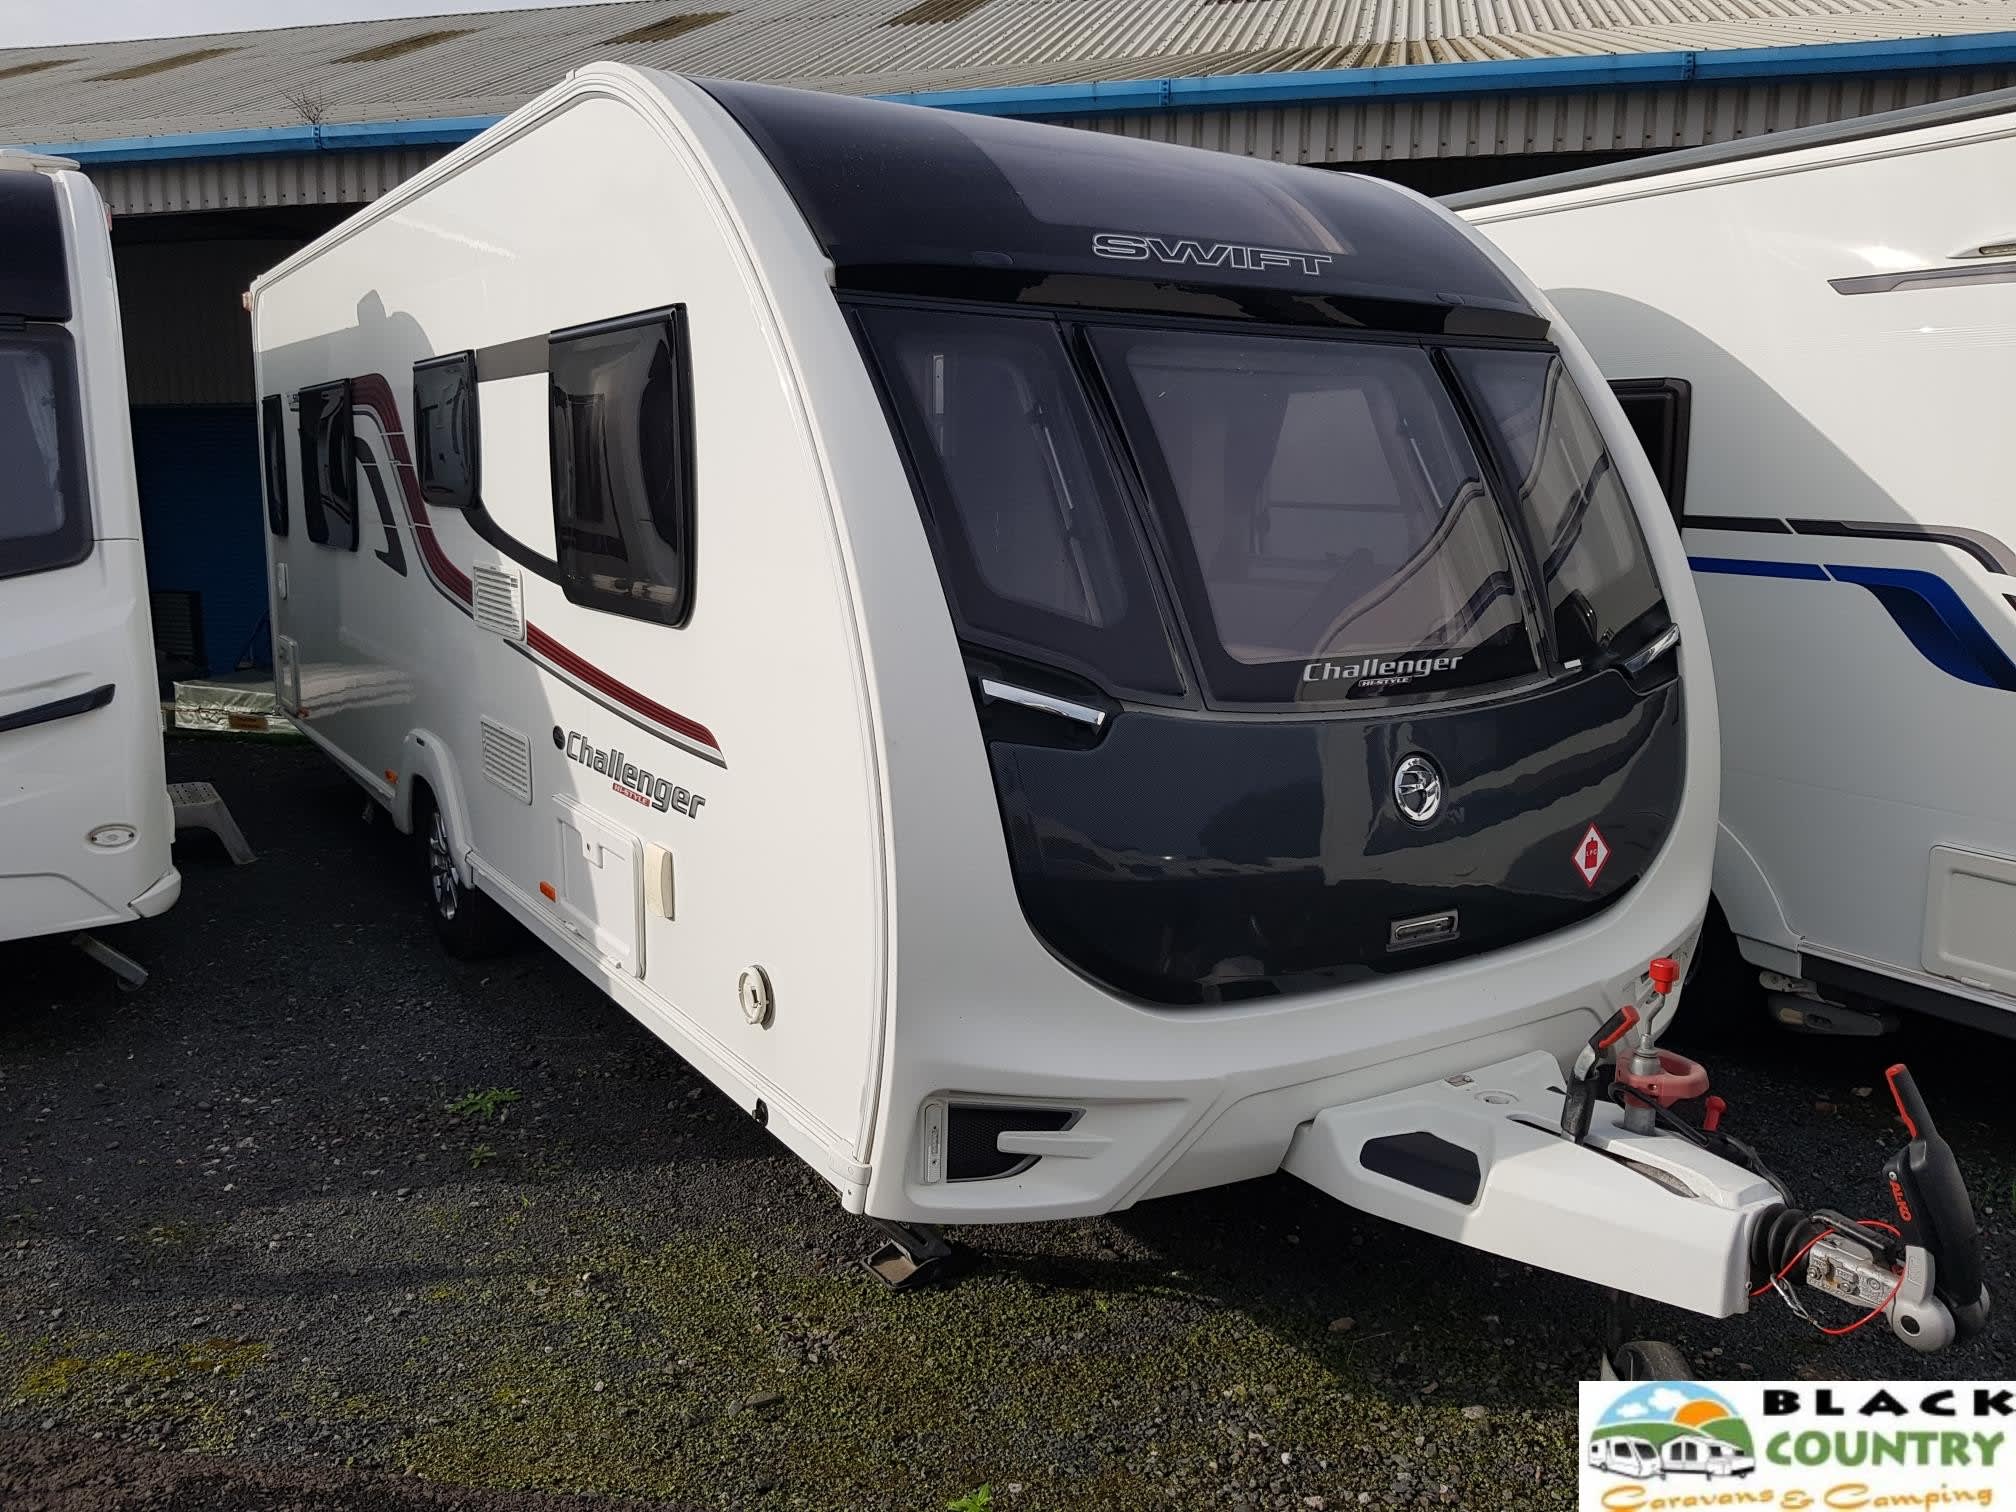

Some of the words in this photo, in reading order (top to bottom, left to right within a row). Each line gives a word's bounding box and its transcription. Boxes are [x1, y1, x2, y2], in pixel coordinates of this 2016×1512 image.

[1093, 233, 1333, 276] SWIFT
[1303, 656, 1463, 682] Challenger
[1361, 676, 1410, 687] HI-STYLE
[567, 730, 706, 819] Challenger
[613, 784, 650, 807] HI-STYLE
